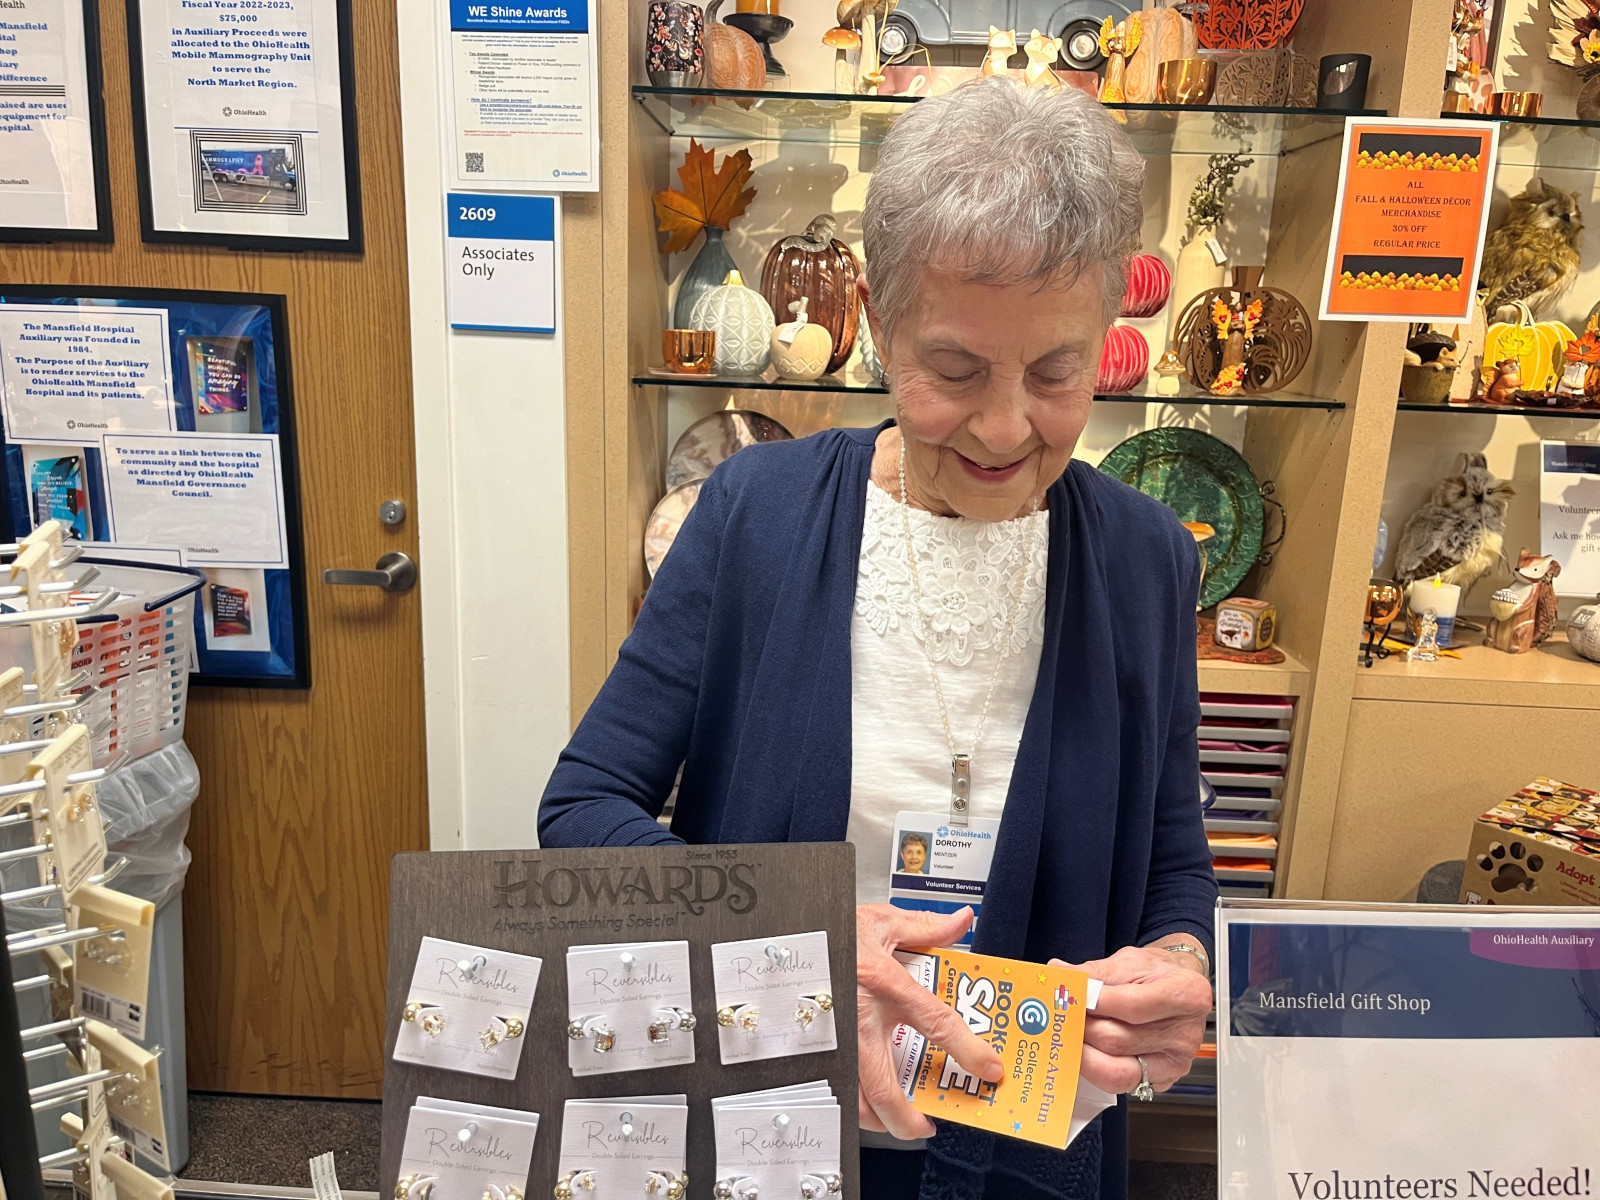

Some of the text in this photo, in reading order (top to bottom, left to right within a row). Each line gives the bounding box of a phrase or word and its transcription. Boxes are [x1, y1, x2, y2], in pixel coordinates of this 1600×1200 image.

[240, 1, 293, 10] 2022-2023,
[468, 6, 567, 18] WE Shine Awards
[219, 15, 257, 23] $75,000
[185, 28, 229, 37] Auxiliary
[232, 29, 279, 37] Proceeds
[252, 41, 310, 49] OhioHealth
[172, 51, 311, 61] Mobile Mammography Unit
[219, 79, 255, 87] Market
[258, 80, 297, 89] Region.
[1407, 181, 1424, 189] ALL
[1355, 195, 1377, 203] FALL
[1389, 196, 1441, 205] HALLOWEEN
[459, 207, 496, 221] 2609
[1381, 209, 1441, 218] MERCHANDISE
[1411, 225, 1427, 233] OFF
[1374, 240, 1441, 248] REGULAR PRICE
[462, 246, 534, 261] Associates
[462, 263, 494, 280] Only
[23, 323, 134, 333] The Mansfield Hospital
[20, 334, 62, 344] Auxiliary
[85, 336, 128, 344] Founded
[130, 336, 140, 344] in
[34, 357, 73, 366] Purpose
[87, 358, 103, 366] the
[105, 359, 149, 369] Auxiliary
[41, 368, 76, 376] render
[77, 369, 116, 377] services
[131, 370, 145, 378] the
[31, 378, 136, 388] OhioHealth Mansfield
[25, 388, 65, 397] Hospital
[87, 390, 99, 398] its
[101, 391, 145, 399] patients.
[116, 447, 127, 455] To
[179, 448, 199, 456] link
[201, 449, 243, 458] between
[120, 459, 176, 468] community
[179, 459, 198, 467] and
[218, 461, 259, 469] hospital
[142, 468, 182, 476] directed
[184, 469, 196, 478] by
[198, 469, 254, 479] OhioHealth
[136, 478, 246, 489] Mansfield Governance
[172, 489, 212, 497] Council.
[1552, 531, 1568, 539] Ask
[1581, 543, 1595, 553] gift
[950, 830, 991, 839] OhioHealth
[936, 839, 971, 848] DOROTHY
[685, 850, 738, 860] Since 1953
[1556, 861, 1595, 885] Adopt
[925, 881, 981, 891] Volunteer Services
[492, 914, 679, 934] Always Something Special
[1493, 934, 1595, 947] OhioHealth Auxiliary
[436, 958, 519, 994] Reersibles
[924, 961, 932, 982] LAST
[586, 962, 674, 994] Reversibles
[945, 968, 956, 999] Great
[600, 996, 620, 1005] Double
[638, 993, 661, 1001] Earrings
[1259, 992, 1431, 1015] Mansfield Gift Shop
[992, 981, 1013, 1046] BOOK
[938, 972, 996, 1096] SAE
[1013, 1040, 1028, 1079] Goods
[900, 1041, 922, 1090] CHRISTMAS
[1037, 1013, 1066, 1123] Books Are Fun
[917, 1053, 933, 1091] prices!
[1019, 1041, 1040, 1103] Collective
[582, 1121, 669, 1149] Revrsibles
[735, 1126, 822, 1156] Reversibles
[1288, 1167, 1591, 1200] Volunteers Needed!
